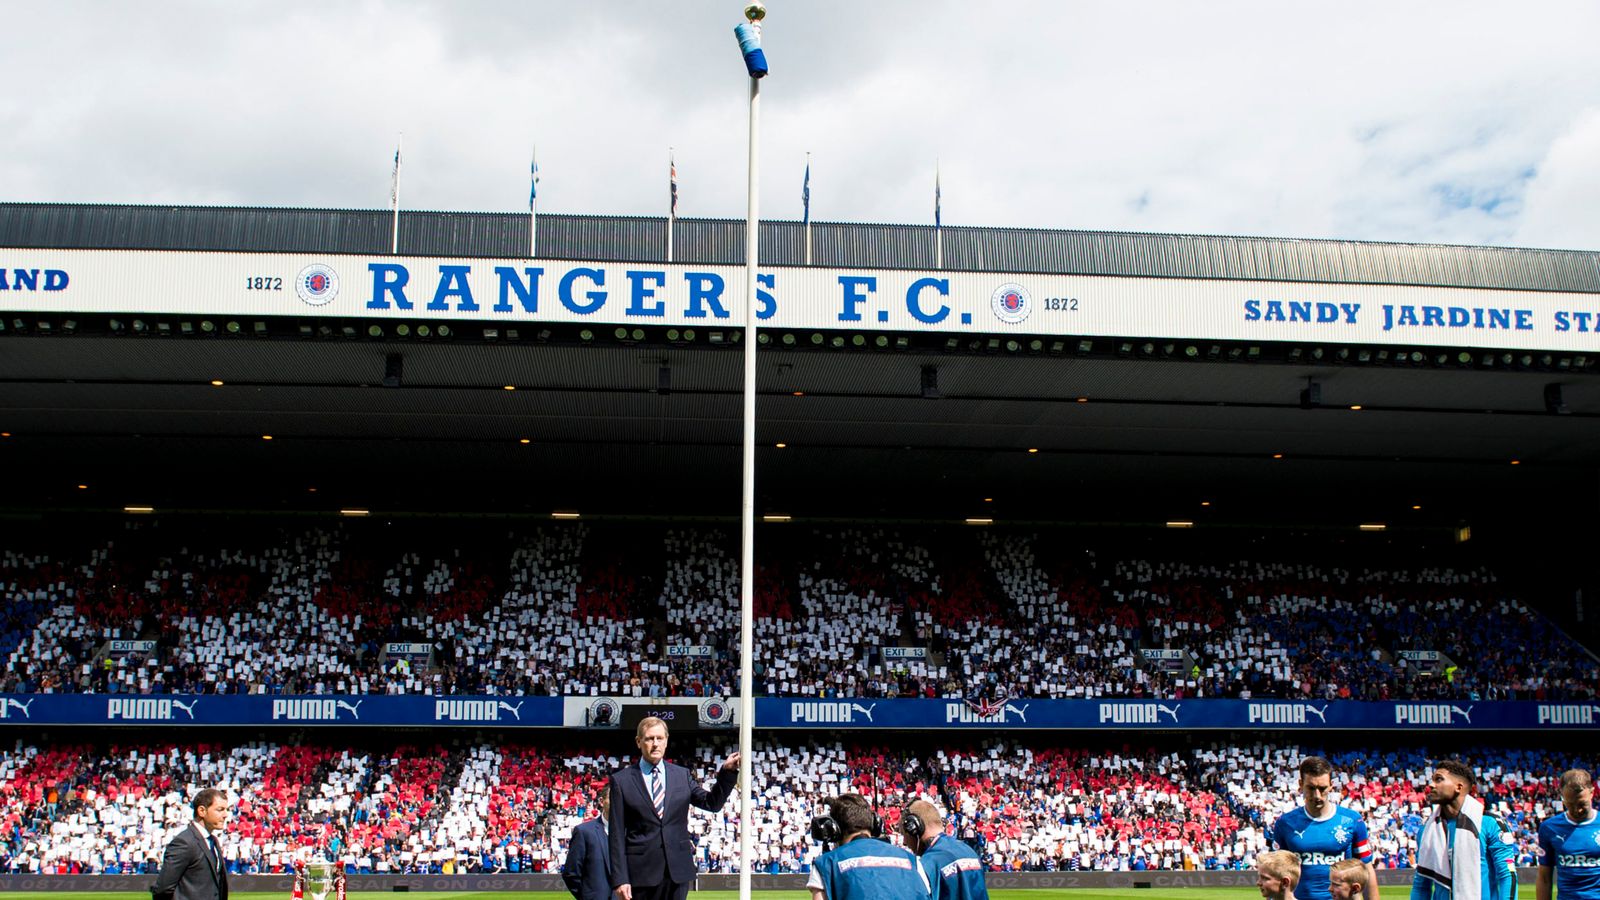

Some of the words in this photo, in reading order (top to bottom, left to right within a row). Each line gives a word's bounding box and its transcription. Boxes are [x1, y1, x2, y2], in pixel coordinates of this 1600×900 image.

[246, 277, 282, 291] 1872
[367, 262, 777, 320] RANGERS
[838, 276, 972, 324] F.C.
[1044, 298, 1079, 312] 1872
[1244, 300, 1361, 324] SANDY
[1382, 304, 1534, 331] JARDINE
[113, 641, 136, 650] EXIT
[143, 641, 154, 650] 10
[421, 644, 429, 652] 11
[698, 646, 709, 655] 12
[885, 648, 906, 656] EXIT
[914, 648, 923, 656] 13
[1143, 650, 1164, 658] EXIT
[1170, 650, 1180, 658] 14
[108, 698, 171, 719] PUMA
[273, 699, 336, 720] PUMA
[435, 700, 497, 720] PUMA
[791, 702, 851, 722] PUMA
[1100, 703, 1156, 722] PUMA
[1248, 703, 1305, 723] PUMA
[1396, 704, 1451, 724] PUMA
[1538, 704, 1592, 724] PUMA
[20, 879, 76, 890] 0871
[88, 879, 128, 890] 702
[433, 879, 468, 890] ON
[476, 879, 531, 889] 0871
[1029, 876, 1080, 887] 1972
[1154, 875, 1213, 886] CALL
